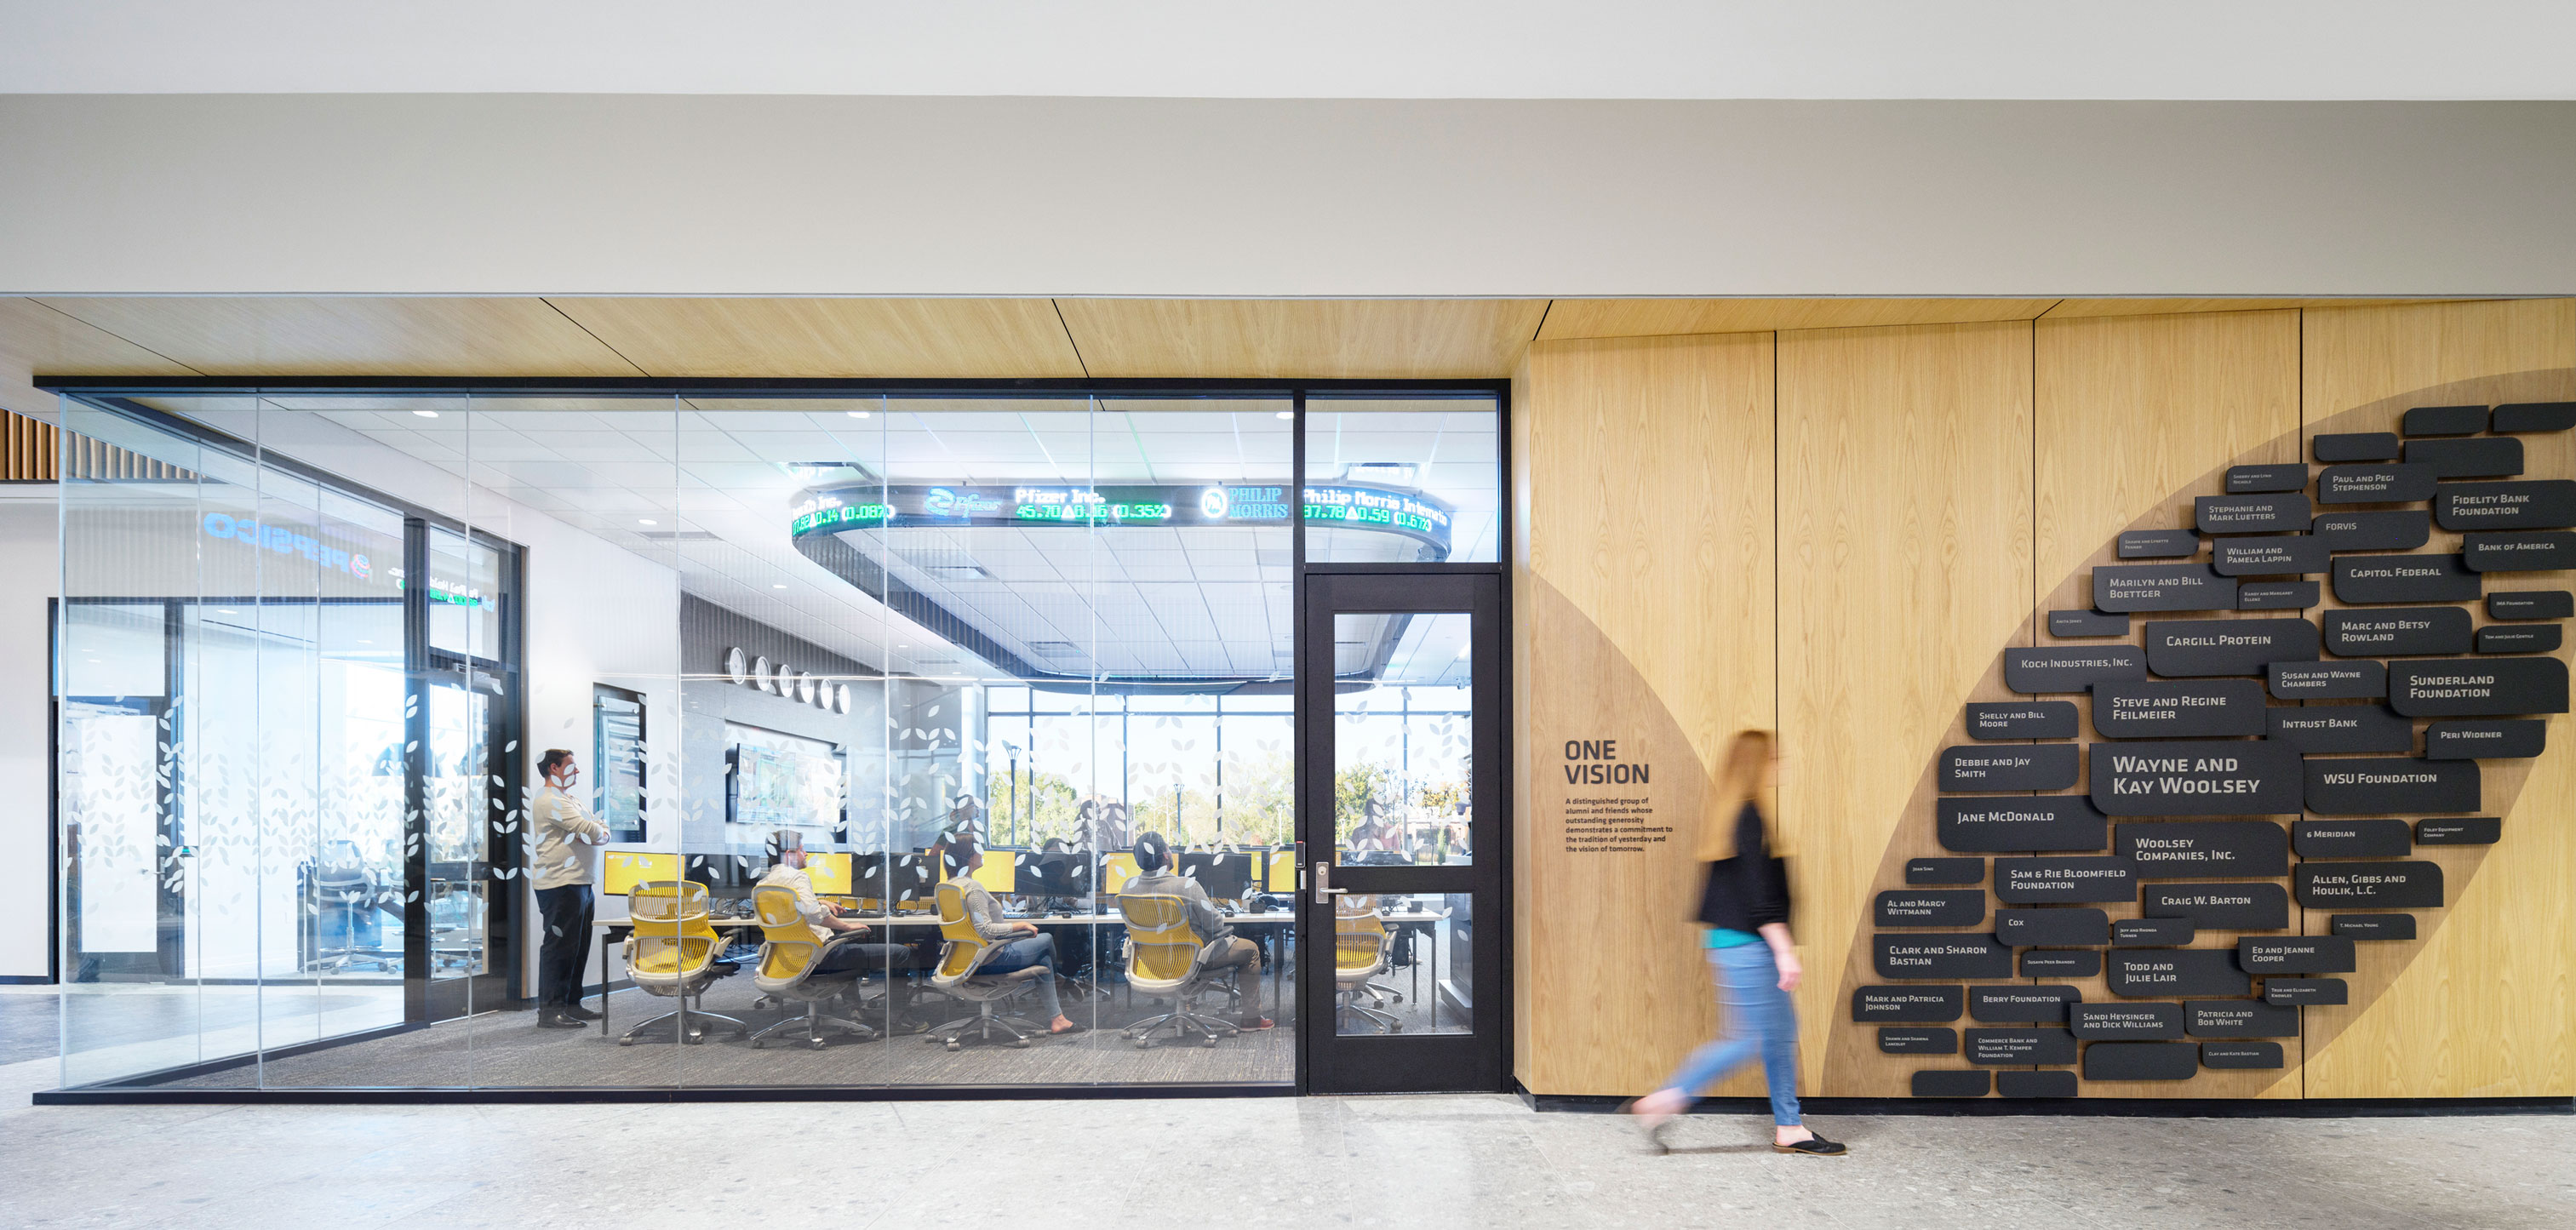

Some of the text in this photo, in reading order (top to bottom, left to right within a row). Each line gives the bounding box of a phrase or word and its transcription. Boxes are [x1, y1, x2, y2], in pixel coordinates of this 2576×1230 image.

[1015, 489, 1106, 504] Pfizer Inc.
[1228, 488, 1282, 502] PHILIP
[1304, 489, 1352, 505] Philip
[1354, 491, 1400, 510] Morris
[2453, 495, 2529, 504] FIDELITY BANK
[1228, 504, 1289, 518] MORRIS
[2453, 507, 2518, 516] FOUNDATION
[2227, 554, 2259, 564] PAMELA
[2351, 568, 2441, 577] CAPITOL FEDERAL
[2109, 579, 2155, 587] MARILYN
[2167, 635, 2270, 646] CARGILL PROTEIN
[2411, 676, 2494, 685] SUNDERLAND
[2411, 688, 2489, 698] FOUNDATION
[2113, 696, 2226, 707] STEVE AND REGINE
[2113, 710, 2175, 719] FEILMEIER
[2329, 718, 2357, 727] BANK
[1566, 740, 1616, 760] ONE
[2113, 756, 2237, 773] WAYNE AND
[1565, 764, 1649, 784] VISION
[2324, 774, 2436, 784] WSU FOUNDATION
[2114, 777, 2260, 794] KAY WOOLSEY
[1958, 812, 2054, 824] JANE MCDONALD
[2136, 838, 2193, 848] WOOLSEY
[2137, 850, 2235, 861] COMPANIES, INC.
[2011, 870, 2032, 878] SAM
[2064, 869, 2126, 878] BLOOMFIELD
[2312, 875, 2349, 884] ALLEN,
[2351, 875, 2382, 884] GIBBS
[2313, 885, 2376, 895] HOULIK, L.C.
[2162, 896, 2191, 905] CRAIG
[2194, 896, 2207, 905] W.
[2284, 947, 2315, 955] JEANNE
[2126, 974, 2150, 984] JULIE
